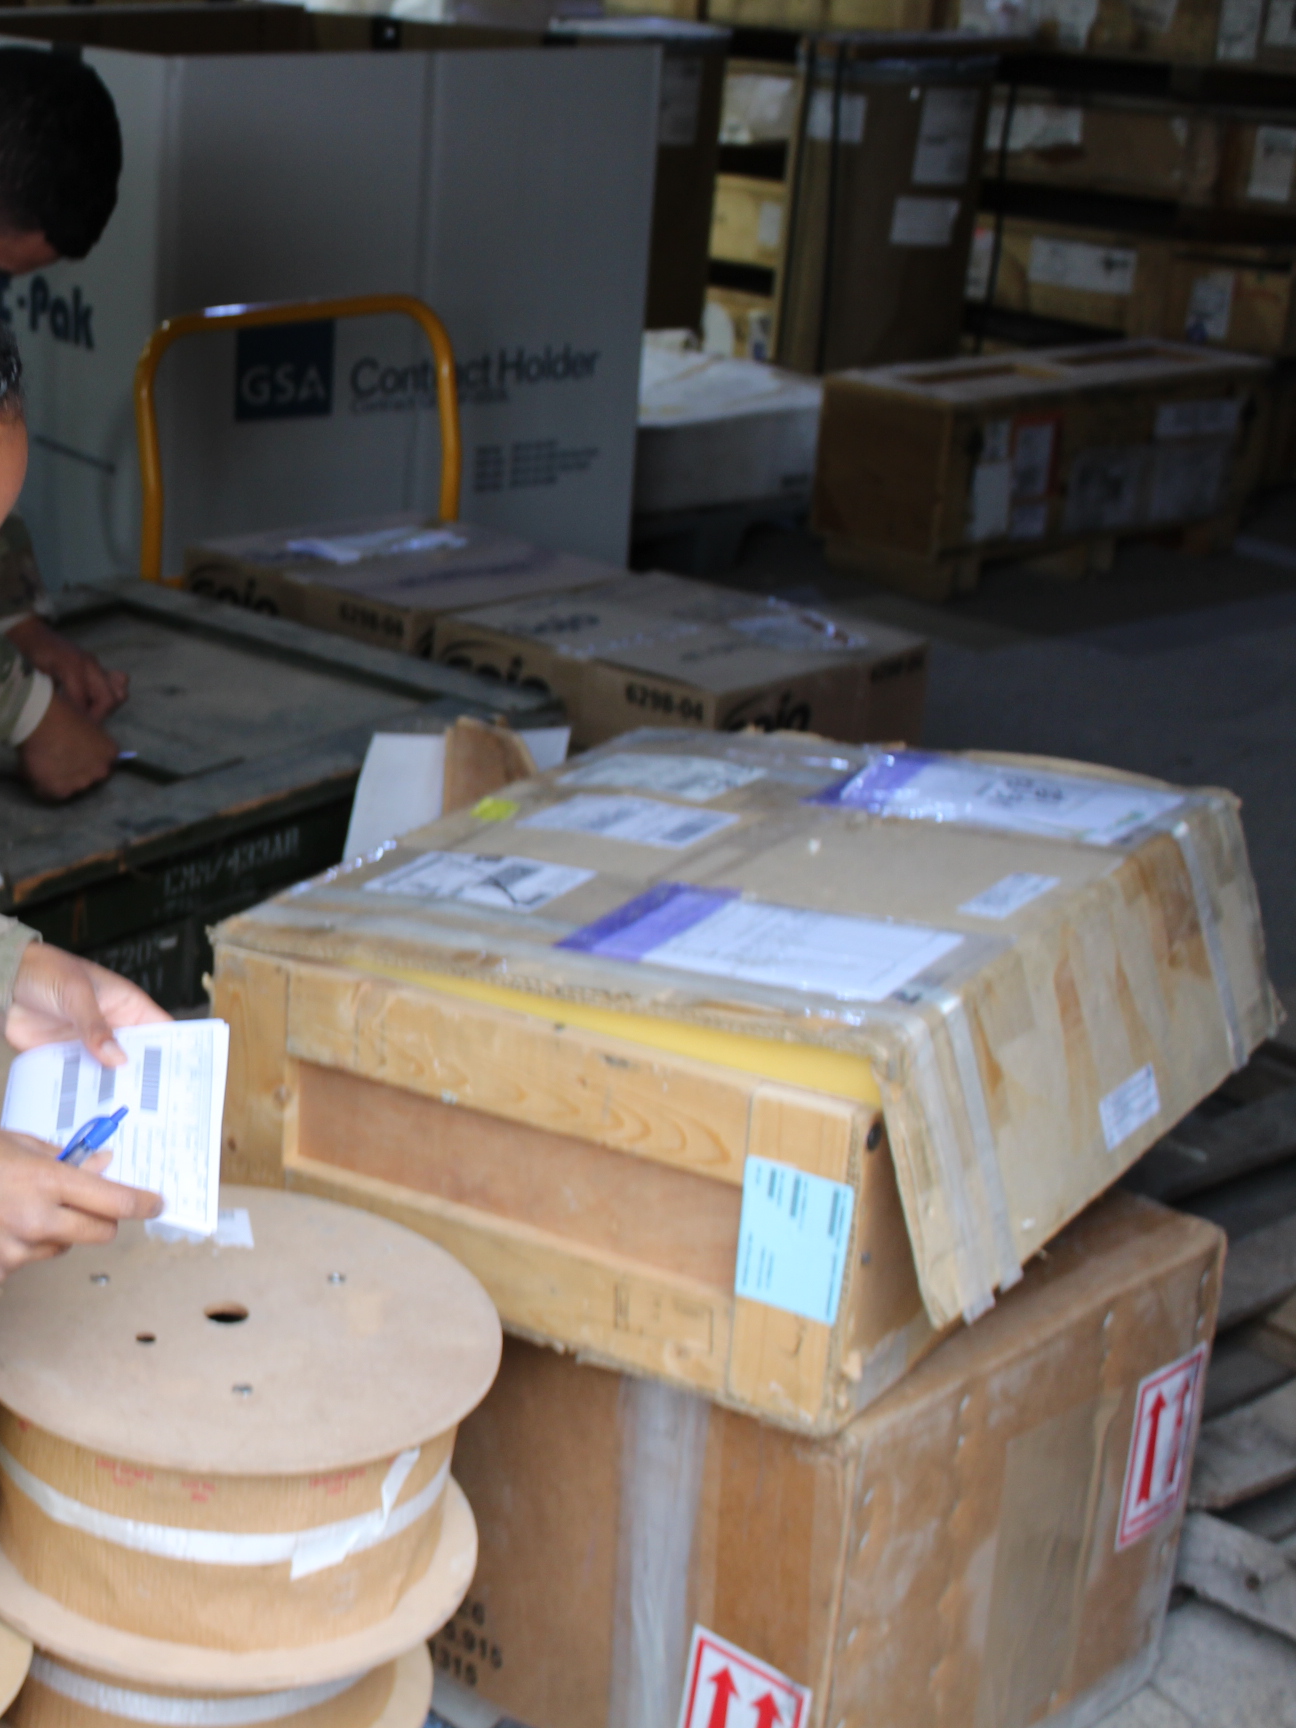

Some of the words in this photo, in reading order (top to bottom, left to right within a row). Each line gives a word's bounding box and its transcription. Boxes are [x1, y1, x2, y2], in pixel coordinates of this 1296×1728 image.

[240, 363, 327, 407] GSA
[350, 353, 491, 398] Contct
[498, 342, 600, 384] Holder
